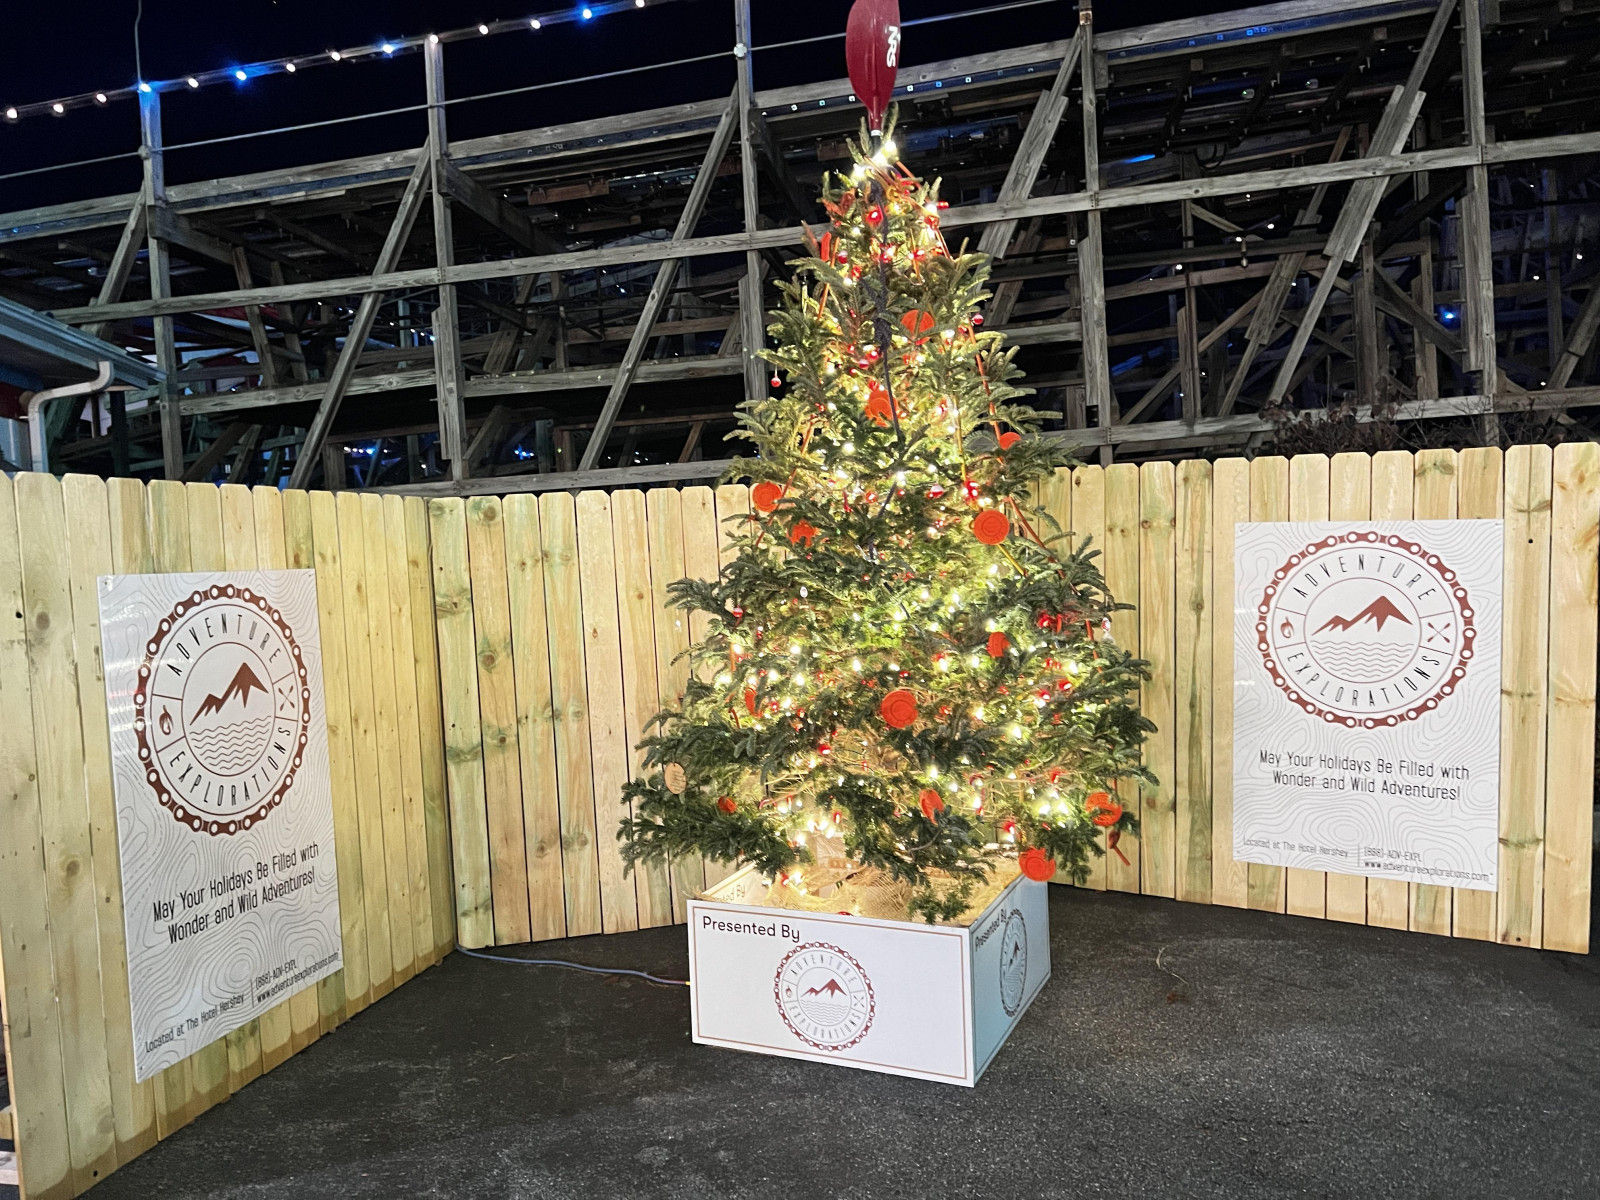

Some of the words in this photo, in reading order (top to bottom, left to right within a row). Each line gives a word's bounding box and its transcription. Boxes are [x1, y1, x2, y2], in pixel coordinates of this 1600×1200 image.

[886, 25, 899, 68] NRS
[1292, 553, 1437, 601] ADVENTURE
[166, 612, 281, 677] ADVENTURE
[1286, 651, 1441, 707] EXPLORATIONS
[169, 726, 291, 807] EXPLORATIONS
[1259, 749, 1282, 767] May
[1286, 751, 1314, 768] Your
[1319, 753, 1371, 775] Holidays
[1377, 758, 1393, 774] Be
[1399, 759, 1434, 778] Filled
[1440, 765, 1470, 780] with
[1272, 770, 1317, 787] Wonder
[1322, 774, 1345, 790] and
[1350, 776, 1376, 793] Wild
[1381, 780, 1461, 801] Adventures!
[1283, 841, 1295, 851] The
[153, 899, 175, 922] May
[179, 887, 205, 912] Your
[209, 869, 253, 897] Holidays
[256, 862, 269, 880] Be
[272, 852, 297, 874] Filled
[300, 841, 319, 862] with
[168, 913, 210, 944] Wonder
[214, 900, 235, 924] and
[237, 892, 258, 915] Wild
[261, 866, 316, 905] Adventures!
[702, 915, 776, 937] Presented
[781, 925, 801, 943] By
[145, 1030, 175, 1053] Located
[176, 1024, 185, 1037] at
[186, 1016, 199, 1032] The
[200, 1004, 218, 1024] Hotel
[219, 993, 245, 1014] Hershey
